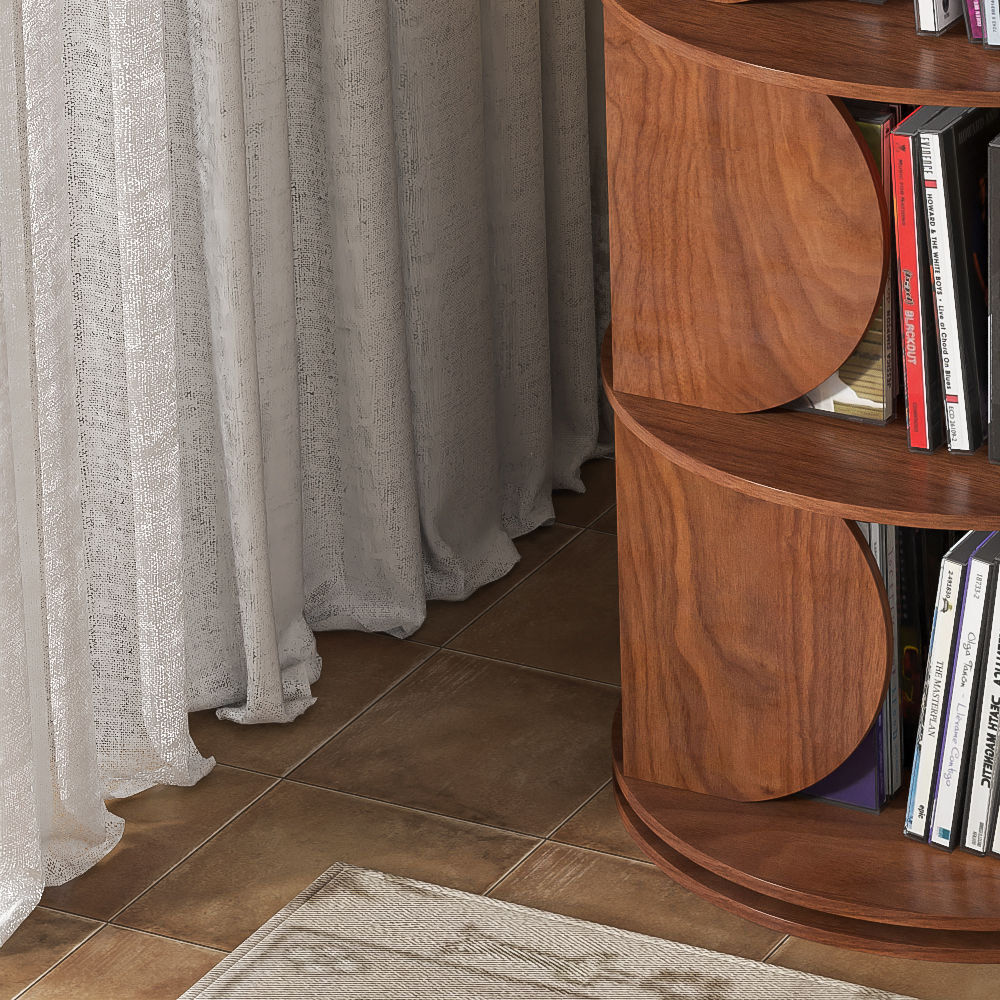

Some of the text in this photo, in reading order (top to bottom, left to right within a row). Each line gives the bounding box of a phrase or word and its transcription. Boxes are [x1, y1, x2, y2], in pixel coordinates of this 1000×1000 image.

[926, 192, 936, 226] HOWARD
[930, 235, 938, 249] THE
[932, 250, 940, 274] WHITE
[934, 275, 942, 295] BOYS
[937, 304, 945, 320] Live
[904, 307, 917, 362] BLACKOUT
[939, 321, 946, 330] at
[940, 332, 949, 354] Chord
[943, 356, 950, 369] On
[944, 369, 952, 390] Blues
[947, 405, 955, 419] ECD
[972, 572, 983, 600] 18733-2
[960, 630, 977, 657] Olga
[926, 659, 944, 738] THE MASTERPLAN
[941, 744, 960, 788] Contigo
[916, 803, 926, 820] epic
